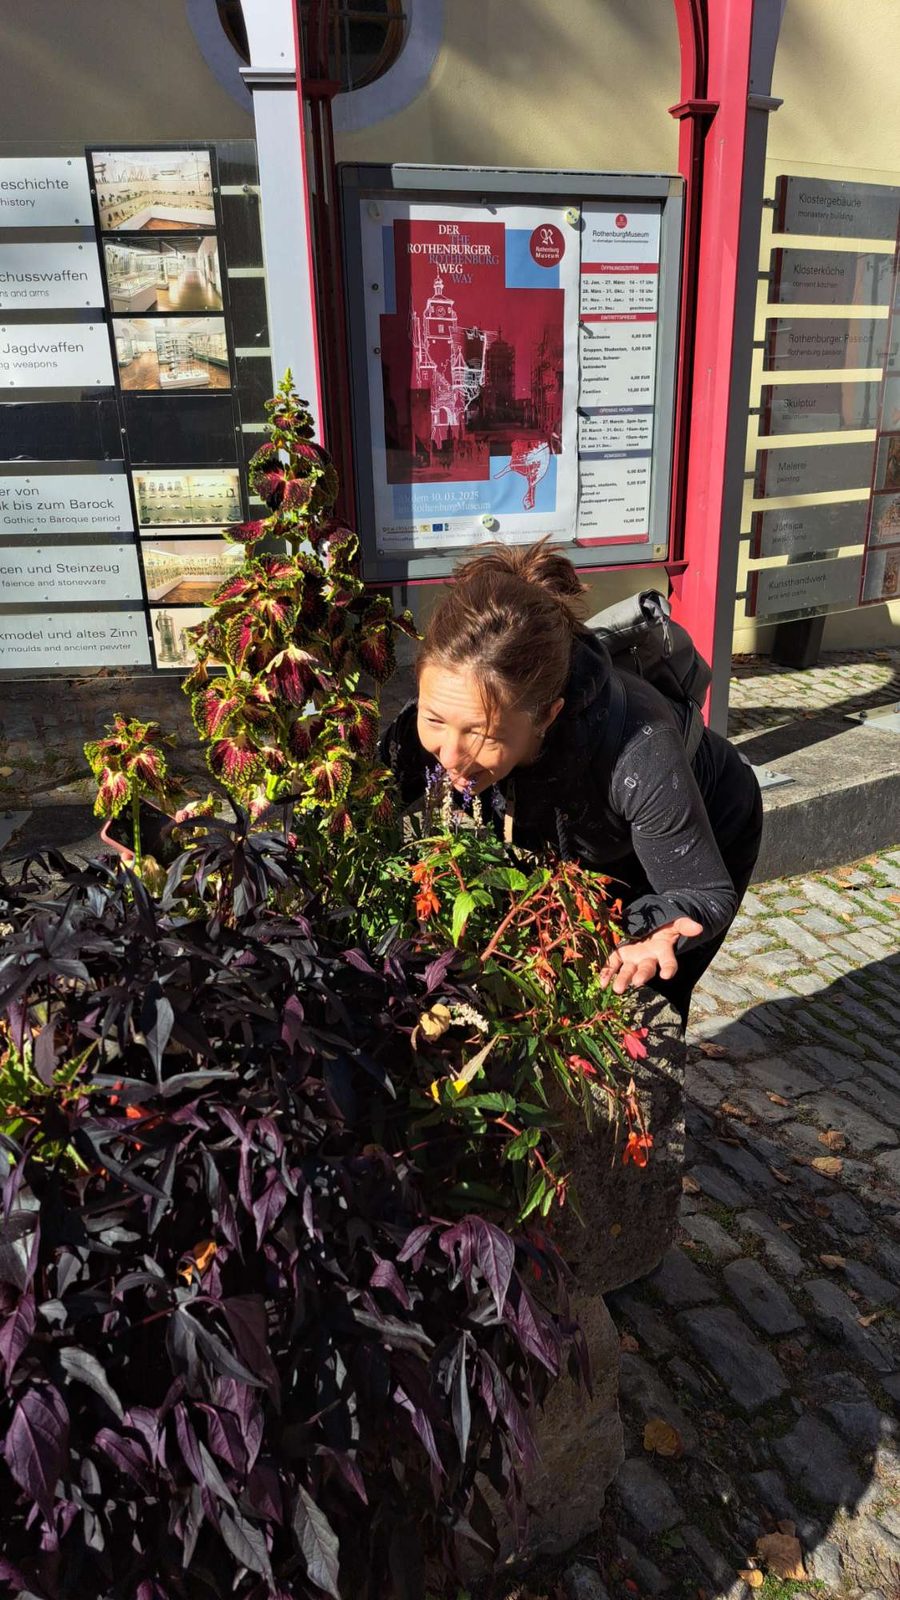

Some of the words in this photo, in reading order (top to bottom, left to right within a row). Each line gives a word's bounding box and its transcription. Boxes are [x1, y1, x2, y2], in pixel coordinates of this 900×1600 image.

[0, 178, 70, 190] eschichte
[0, 198, 36, 208] history
[438, 224, 460, 235] DER
[592, 230, 650, 238] RothenburgMuseum
[450, 234, 471, 245] THE
[408, 244, 491, 255] ROTHENBURGER
[429, 254, 499, 265] ROTHENBURG
[438, 264, 463, 274] WEG
[794, 264, 845, 276] Klosterküche
[0, 270, 88, 282] chusswaffen
[452, 273, 473, 284] WAY
[10, 289, 27, 298] and
[29, 290, 50, 298] arms
[789, 333, 842, 346] Rothenburger
[2, 341, 84, 356] Jagdwaffen
[12, 360, 58, 370] weapons
[784, 398, 816, 410] Skulptur
[778, 460, 808, 471] Malerei
[15, 487, 40, 496] von
[13, 500, 33, 510] bis
[36, 501, 66, 511] zum
[70, 498, 115, 510] Barock
[4, 515, 34, 524] Gothic
[50, 515, 89, 526] Baroque
[92, 514, 121, 524] period
[0, 566, 23, 575] cen
[27, 564, 52, 574] und
[56, 562, 120, 576] Steinzeug
[2, 579, 35, 588] faience
[38, 579, 55, 588] and
[58, 579, 106, 587] stoneware
[768, 574, 827, 589] Kunsthandwerk
[48, 630, 72, 640] und
[76, 629, 106, 640] altes
[110, 628, 138, 639] Zinn
[8, 645, 41, 653] moulds
[44, 644, 61, 653] and
[64, 644, 98, 652] ancient
[100, 642, 132, 652] pewter
